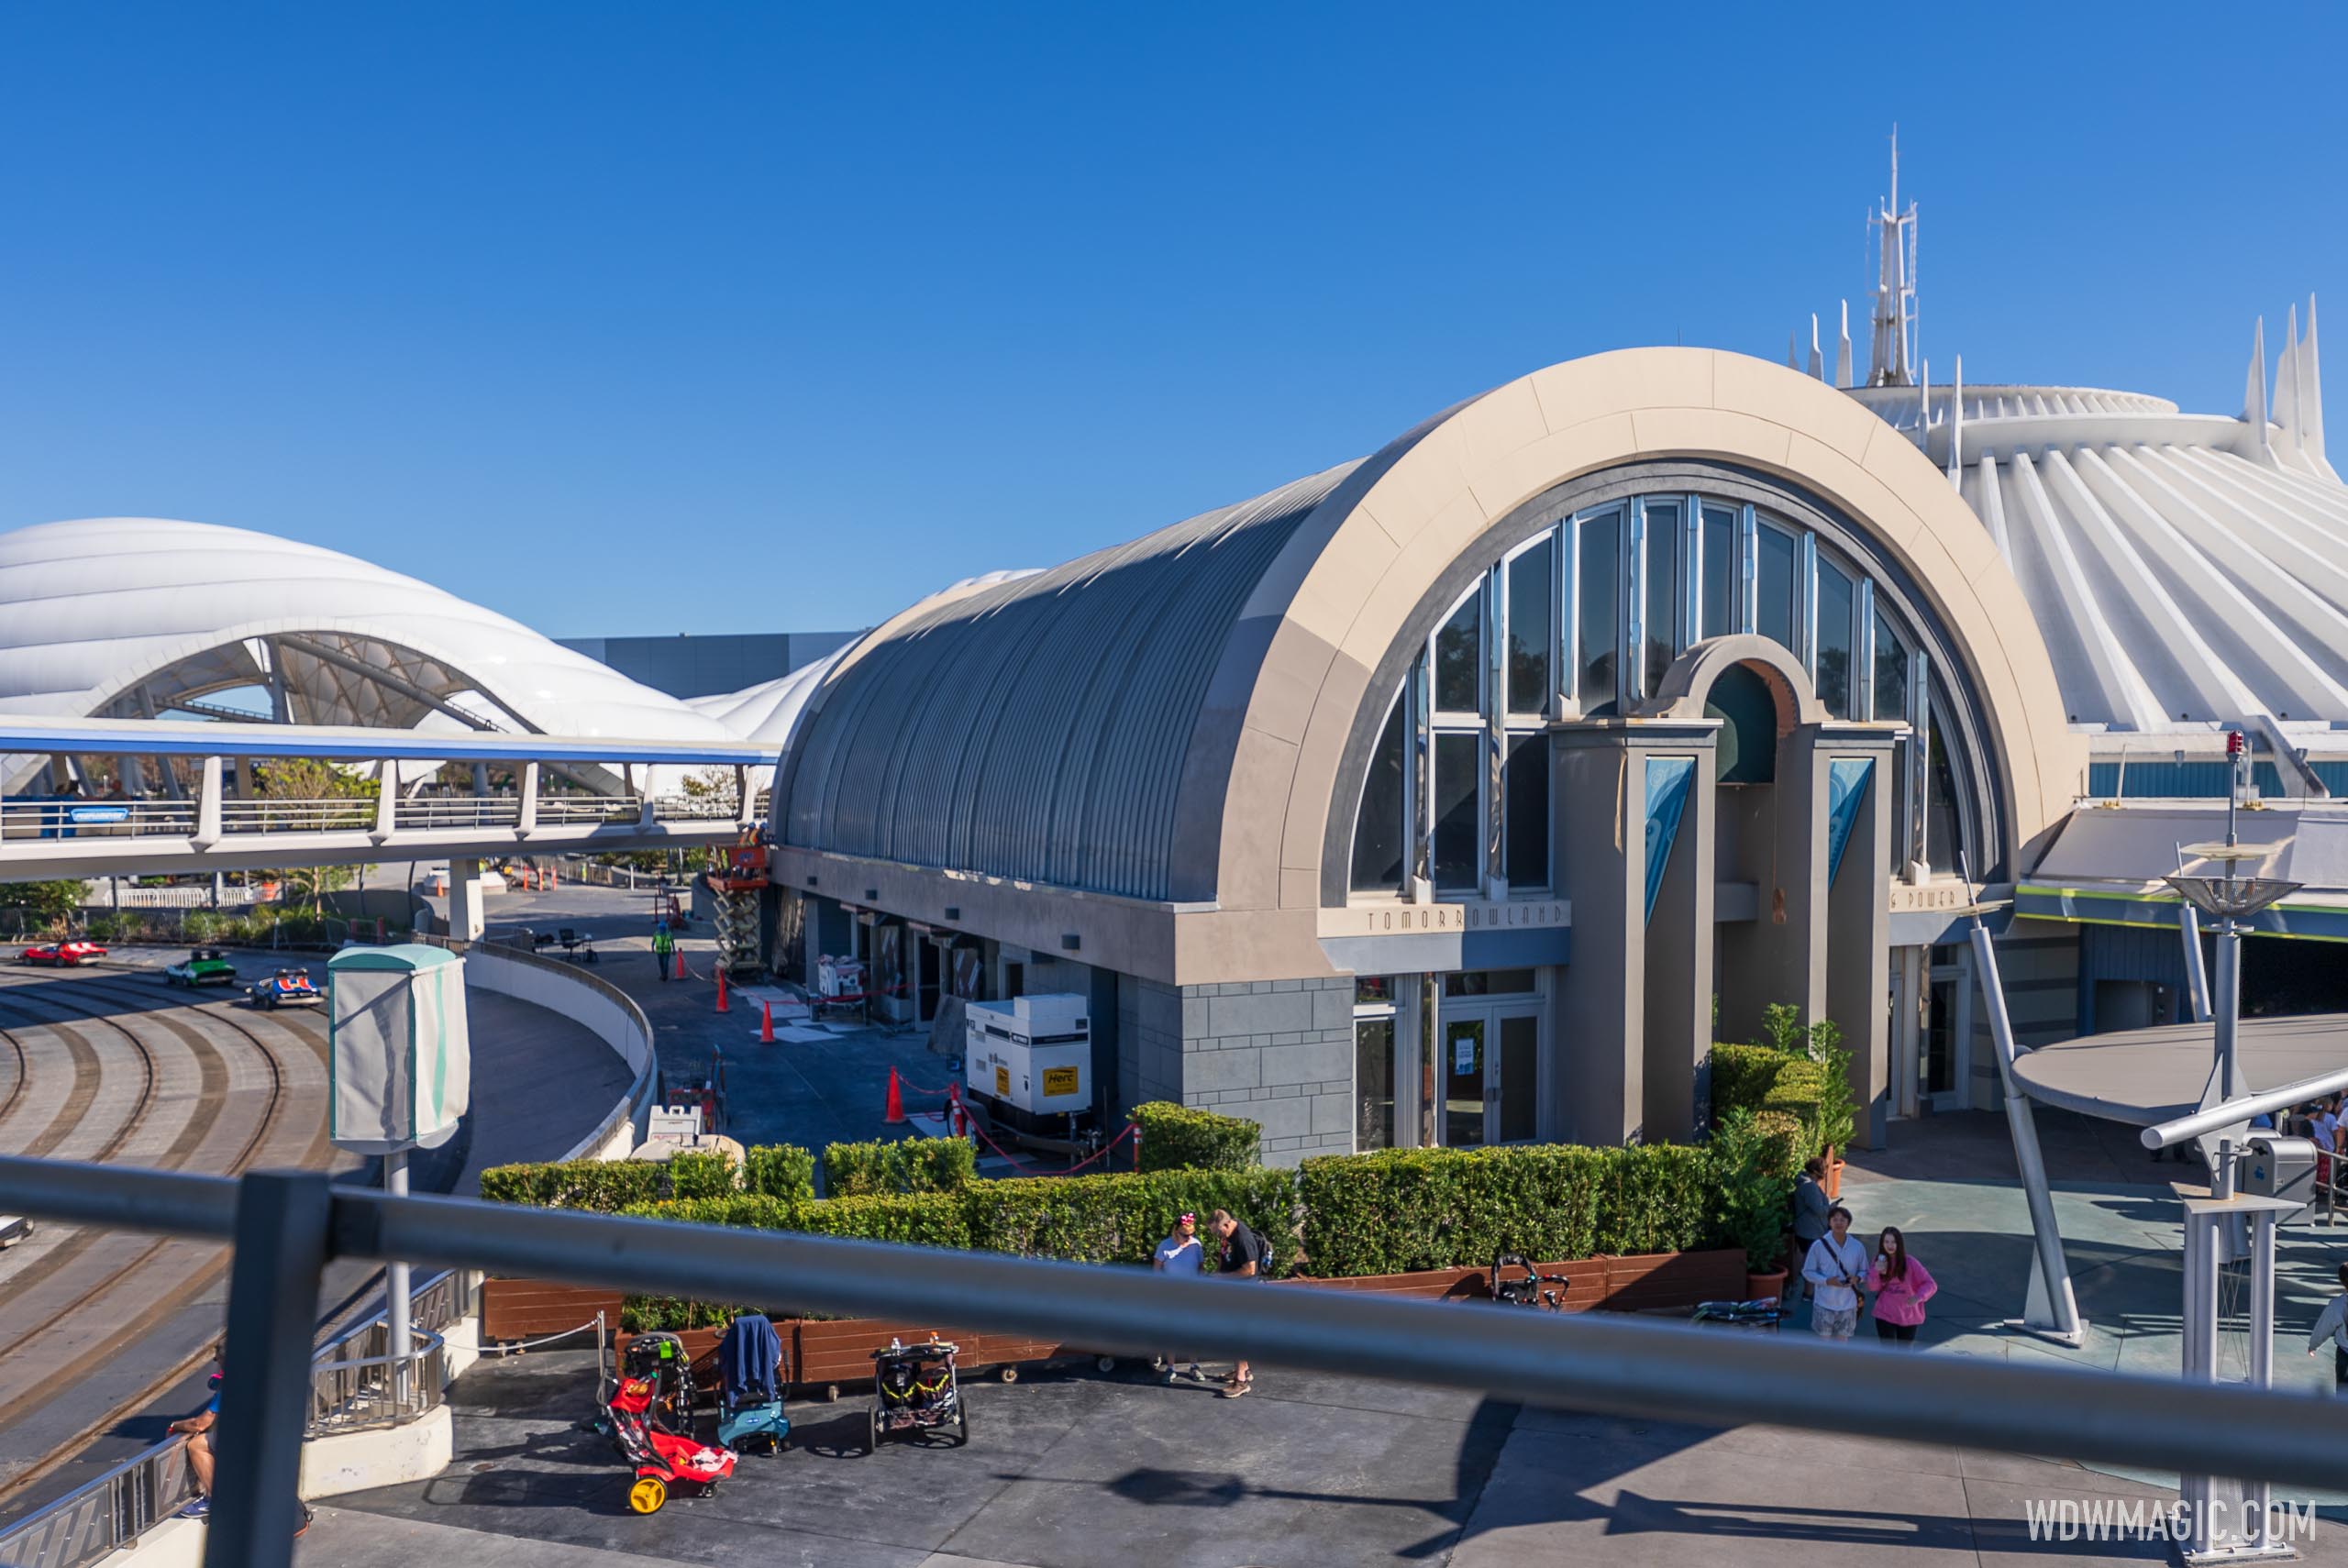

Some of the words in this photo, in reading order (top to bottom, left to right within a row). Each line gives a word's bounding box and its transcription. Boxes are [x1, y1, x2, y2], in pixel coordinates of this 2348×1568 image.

[1908, 889, 1955, 908] POWER
[1368, 905, 1562, 931] TOMORROWLAND
[1048, 1074, 1073, 1084] Herc
